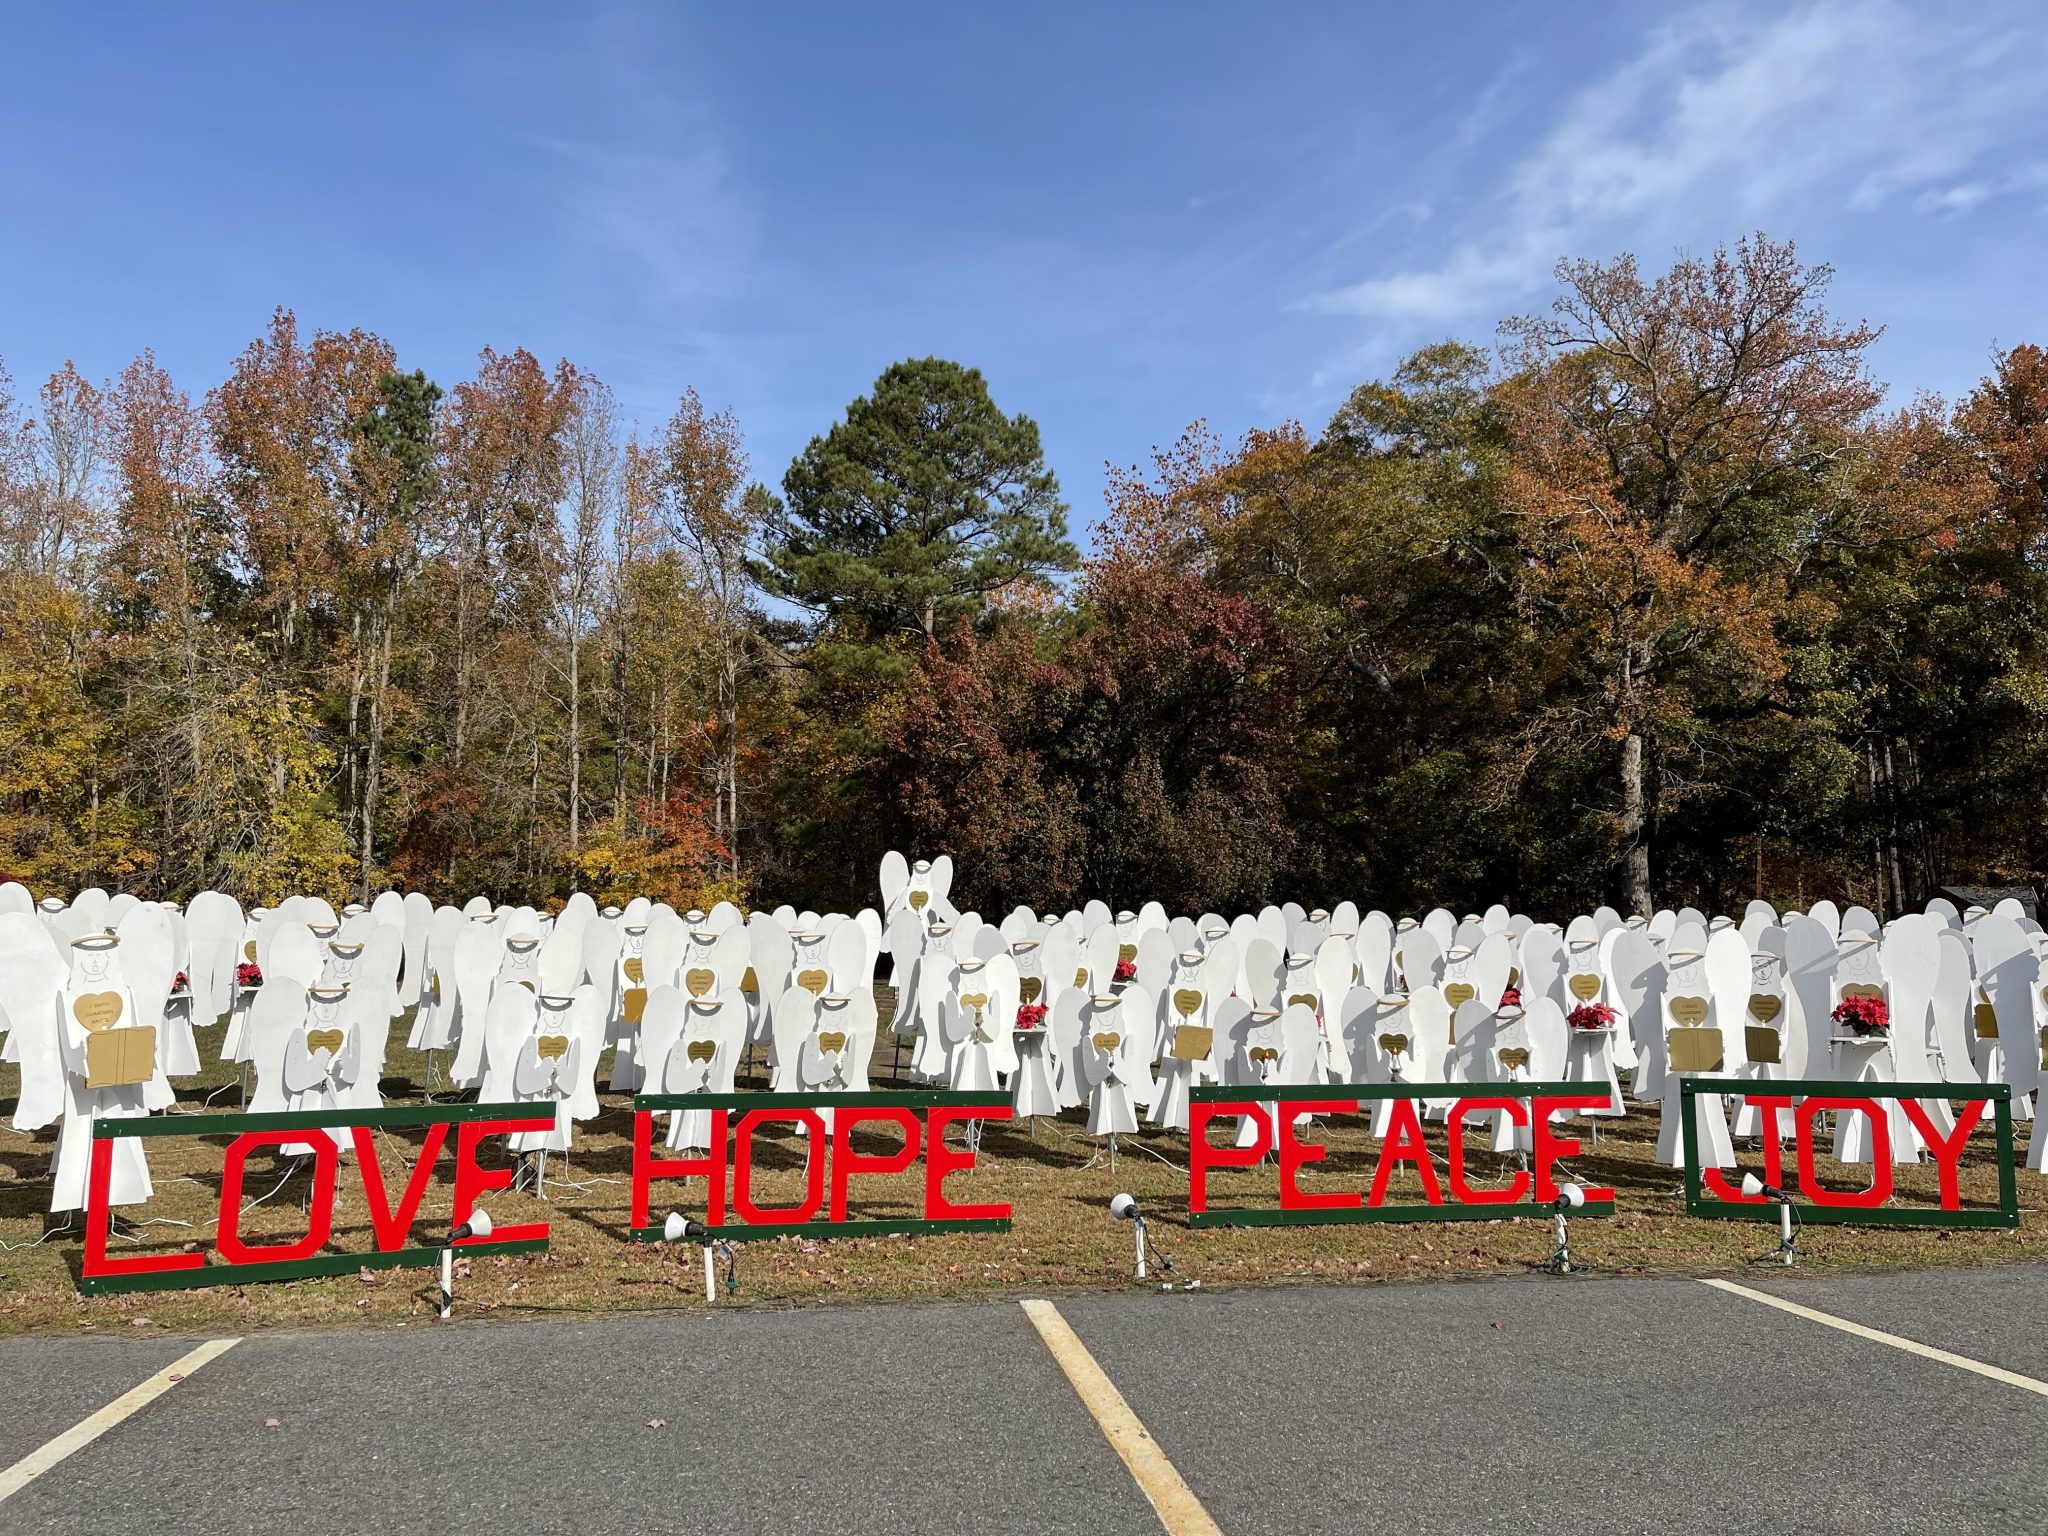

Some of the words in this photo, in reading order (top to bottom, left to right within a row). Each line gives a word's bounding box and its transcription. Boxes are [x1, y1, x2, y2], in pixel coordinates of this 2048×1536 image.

[83, 1119, 554, 1277] LOVE
[631, 1107, 1013, 1229] HOPE
[1190, 1096, 1615, 1213] PEACE
[1705, 1096, 1985, 1210] JOY
